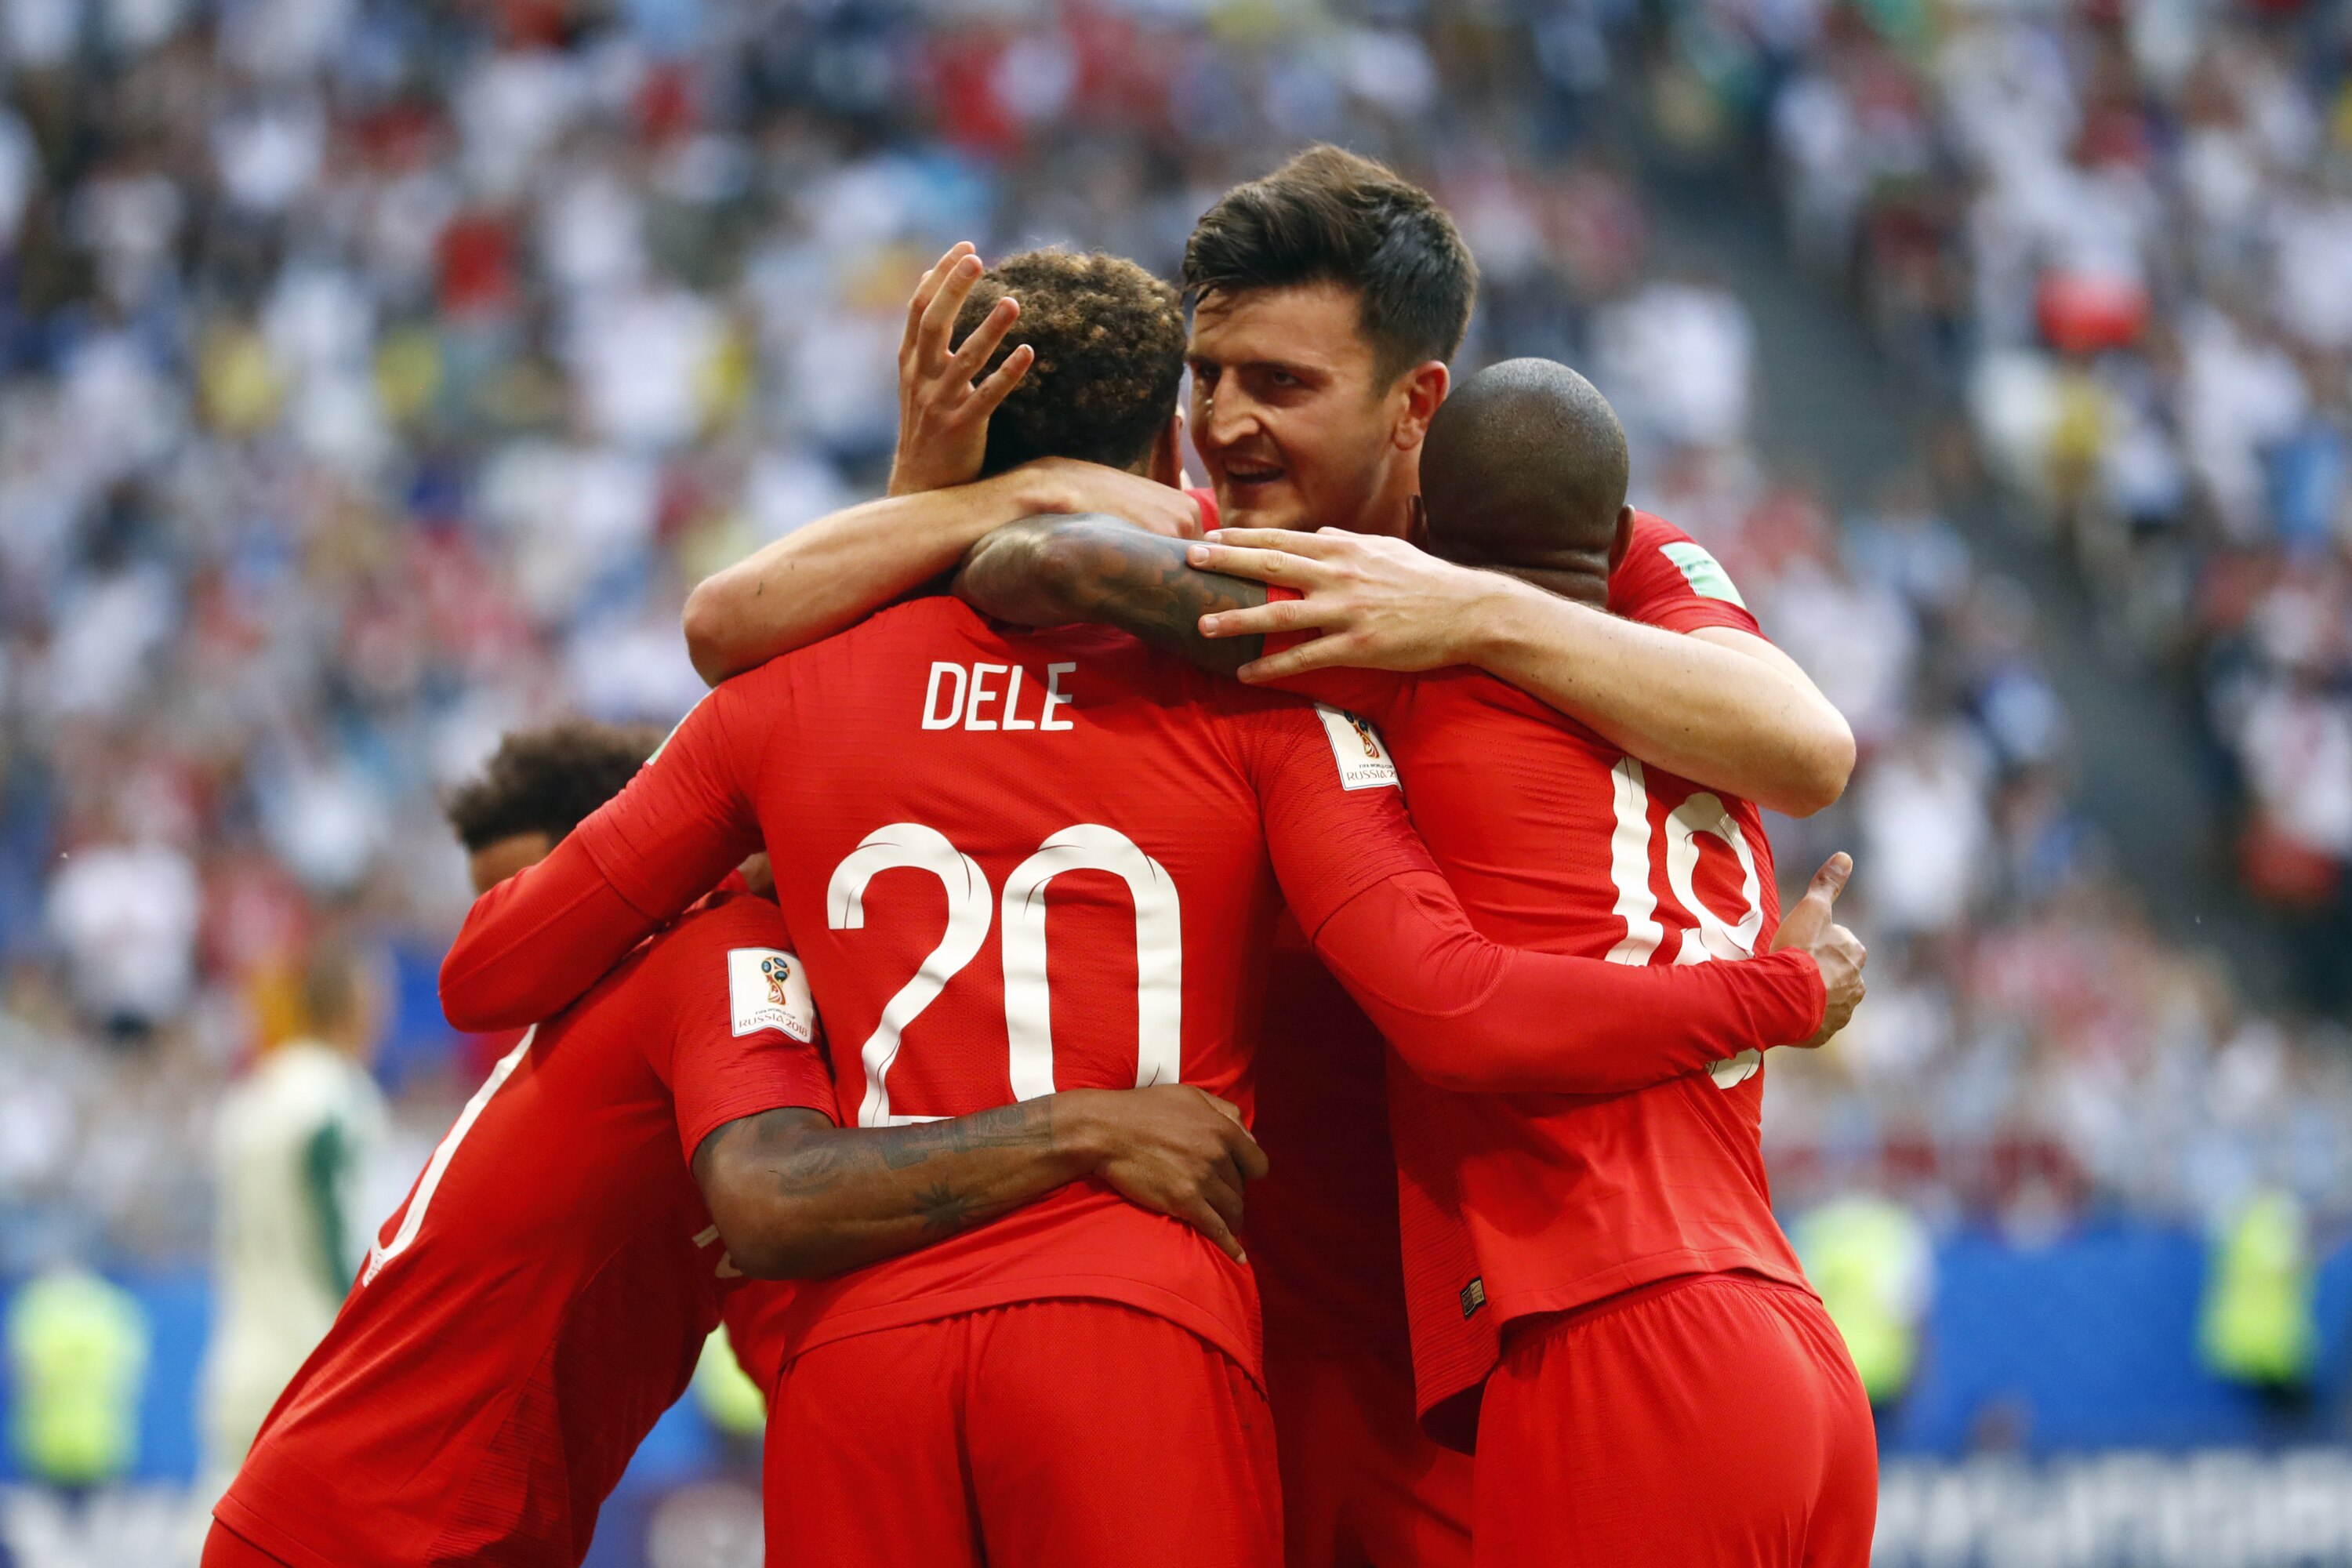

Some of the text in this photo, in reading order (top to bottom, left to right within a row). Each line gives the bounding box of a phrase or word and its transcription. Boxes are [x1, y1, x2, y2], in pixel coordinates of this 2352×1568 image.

[921, 661, 1076, 731] DELE
[1346, 769, 1387, 781] RUSSIA
[827, 822, 1182, 1127] 20
[739, 1013, 808, 1037] RUSSIA 2018
